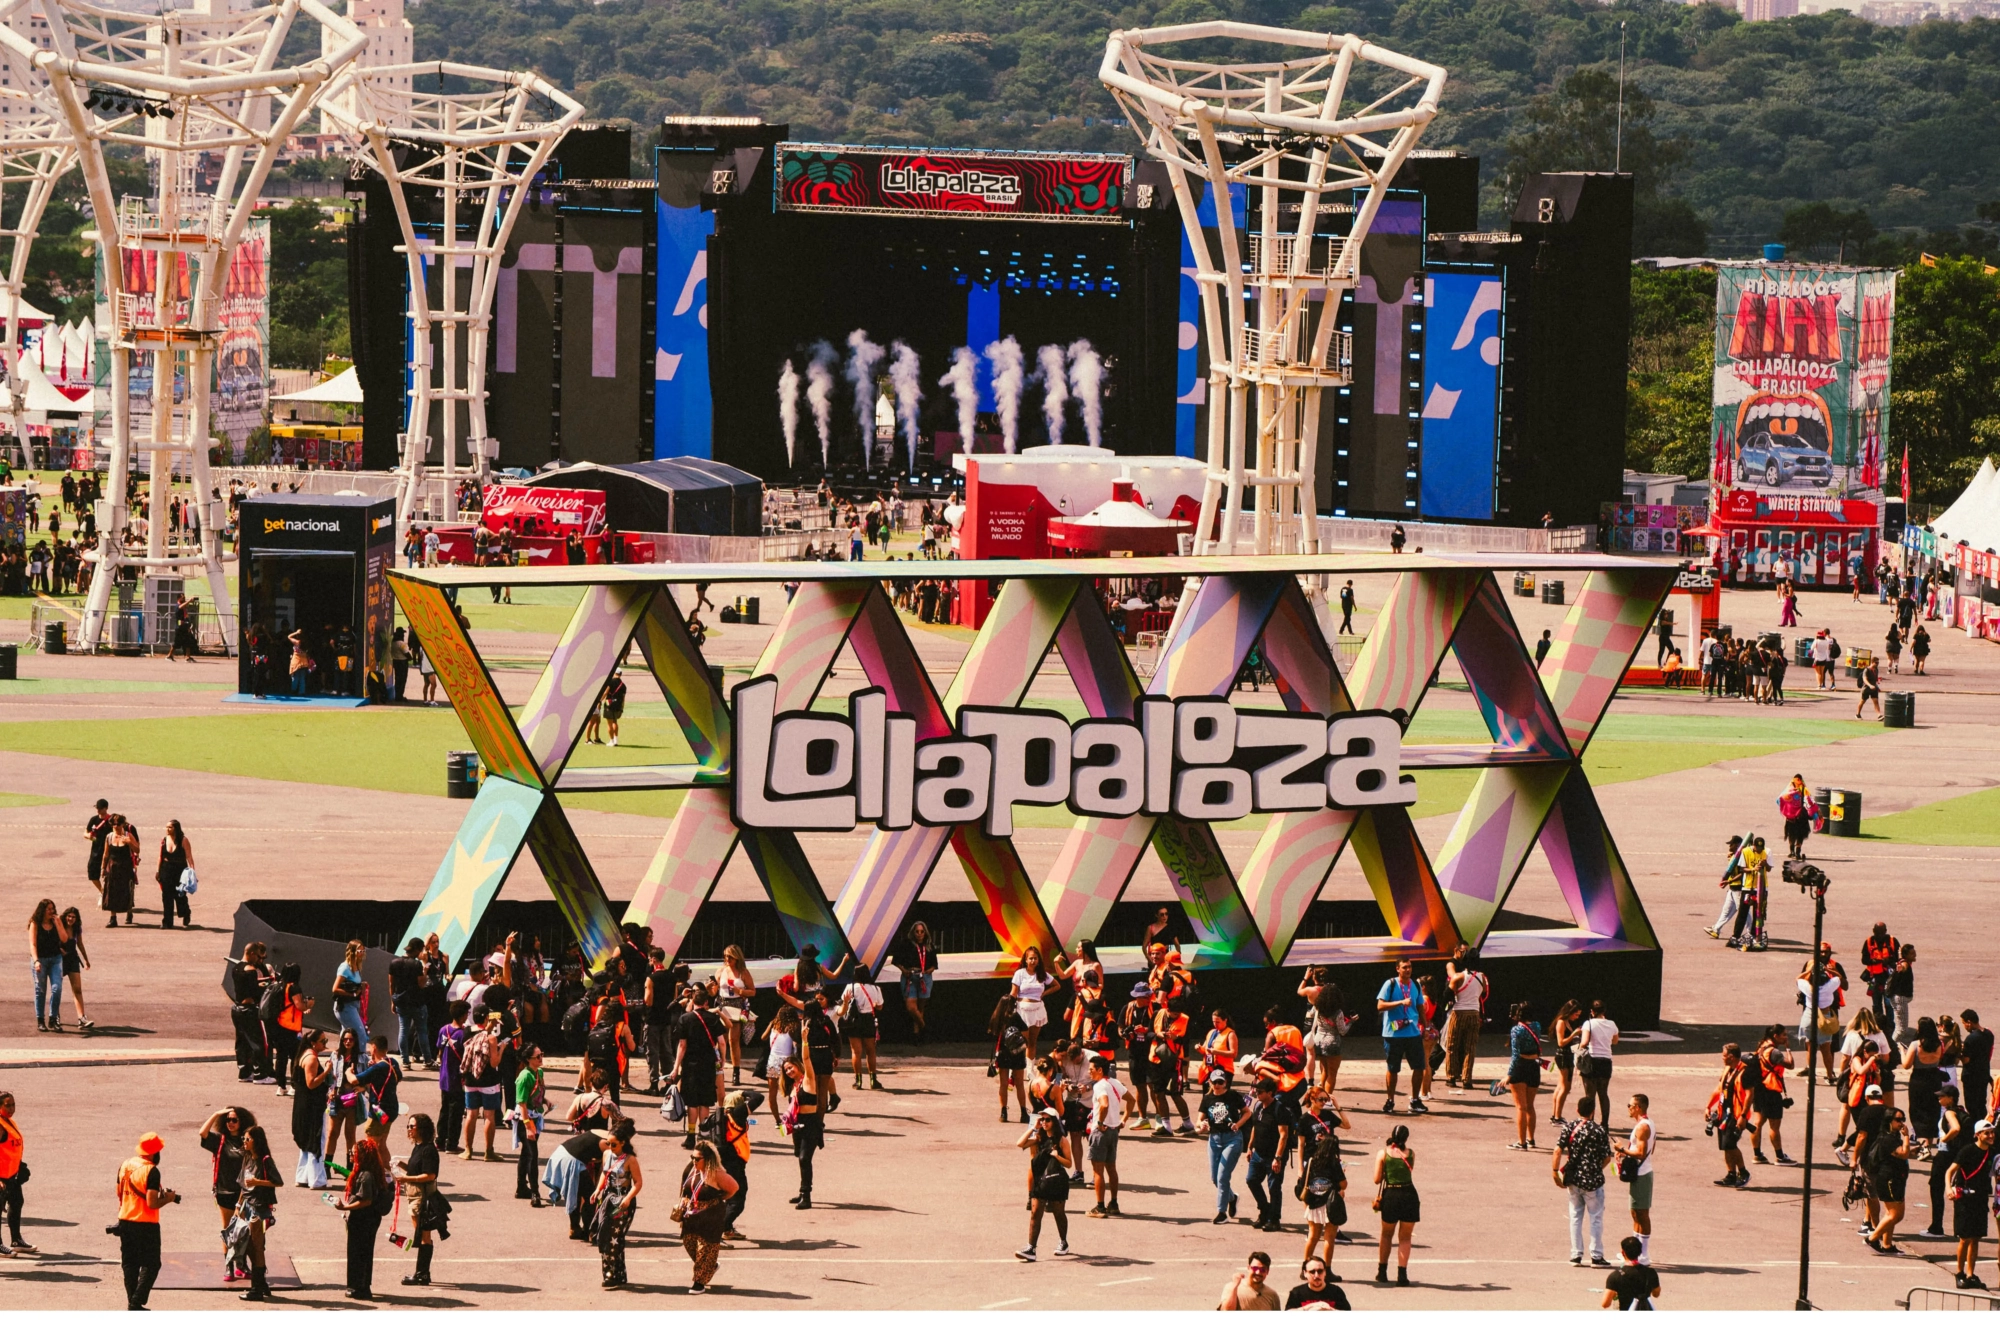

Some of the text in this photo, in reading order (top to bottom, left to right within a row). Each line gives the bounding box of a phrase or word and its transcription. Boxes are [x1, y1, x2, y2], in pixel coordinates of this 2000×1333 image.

[882, 163, 1020, 196] Lollapalooza
[986, 194, 1014, 202] BRASIL
[1729, 291, 1842, 360] FIAT
[1732, 358, 1839, 380] LOLLAPALOOZA
[1761, 379, 1810, 395] BRASIL
[483, 484, 584, 510] Budweiser
[1768, 497, 1841, 513] WATER STATION
[733, 677, 1417, 837] Lollapalooza
